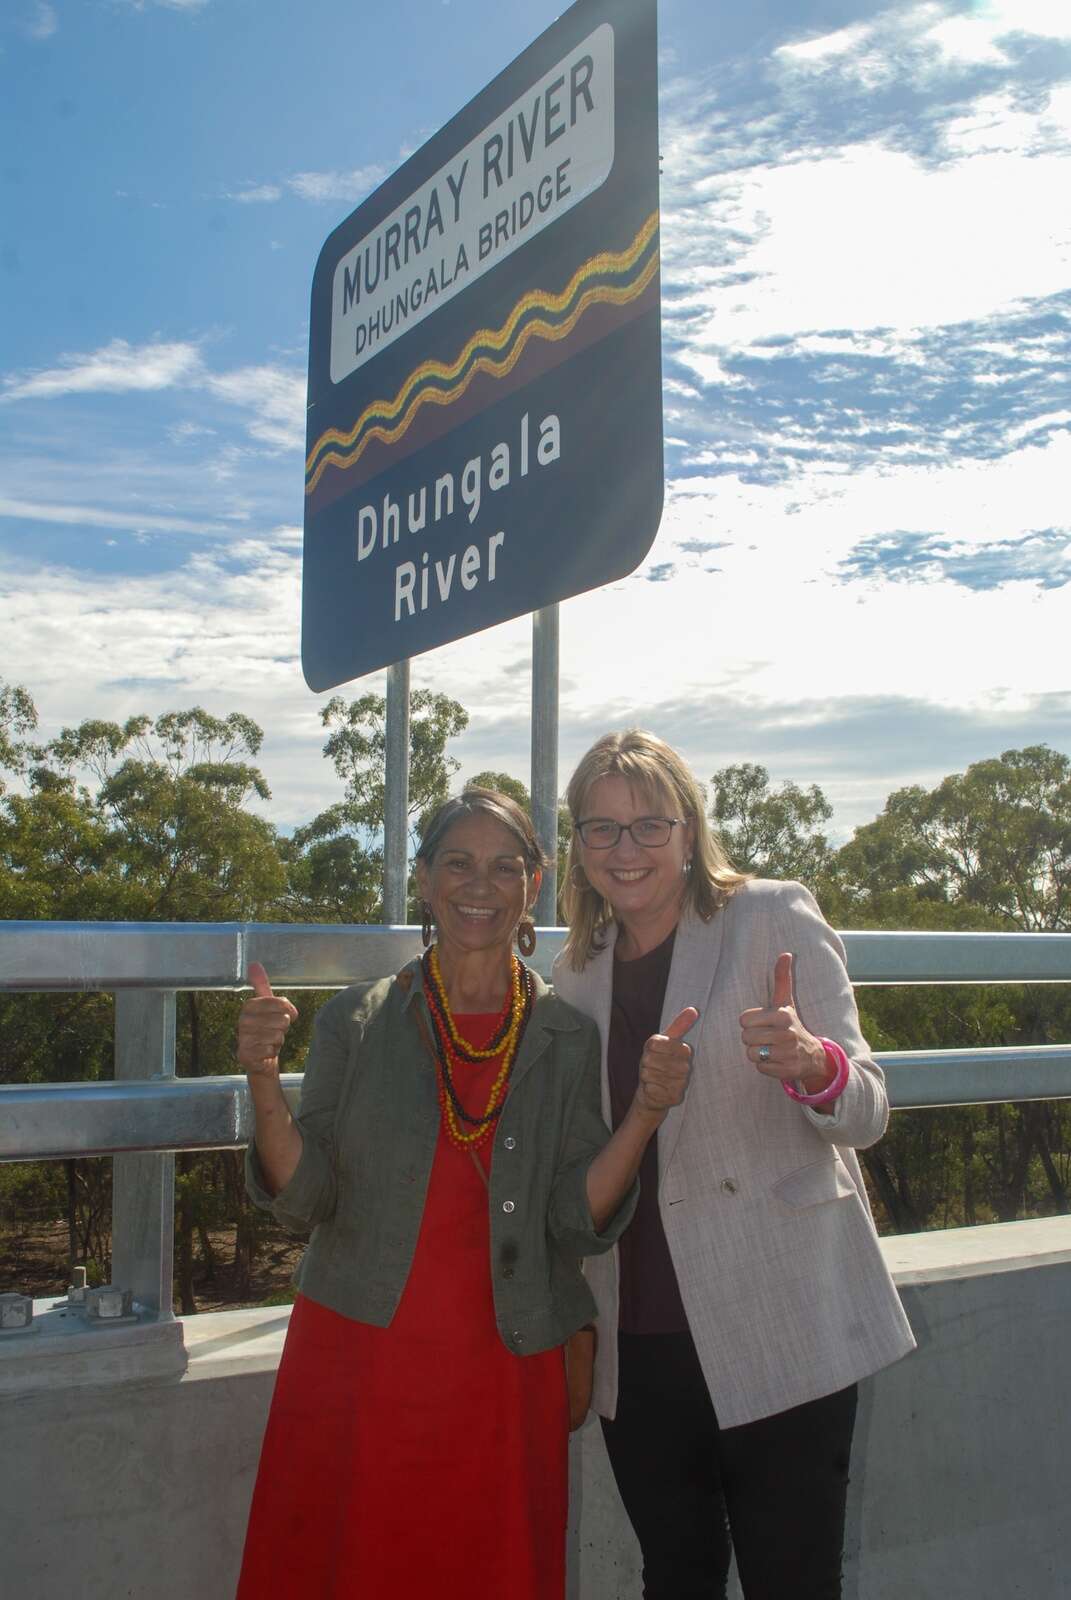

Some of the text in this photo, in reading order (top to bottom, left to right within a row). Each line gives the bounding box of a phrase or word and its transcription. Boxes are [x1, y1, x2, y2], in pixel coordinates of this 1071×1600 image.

[342, 55, 595, 315] MURRAY RIVER
[355, 158, 572, 356] DHUNGALA BRIDGE
[357, 411, 561, 561] Dhungala
[394, 531, 505, 622] River
